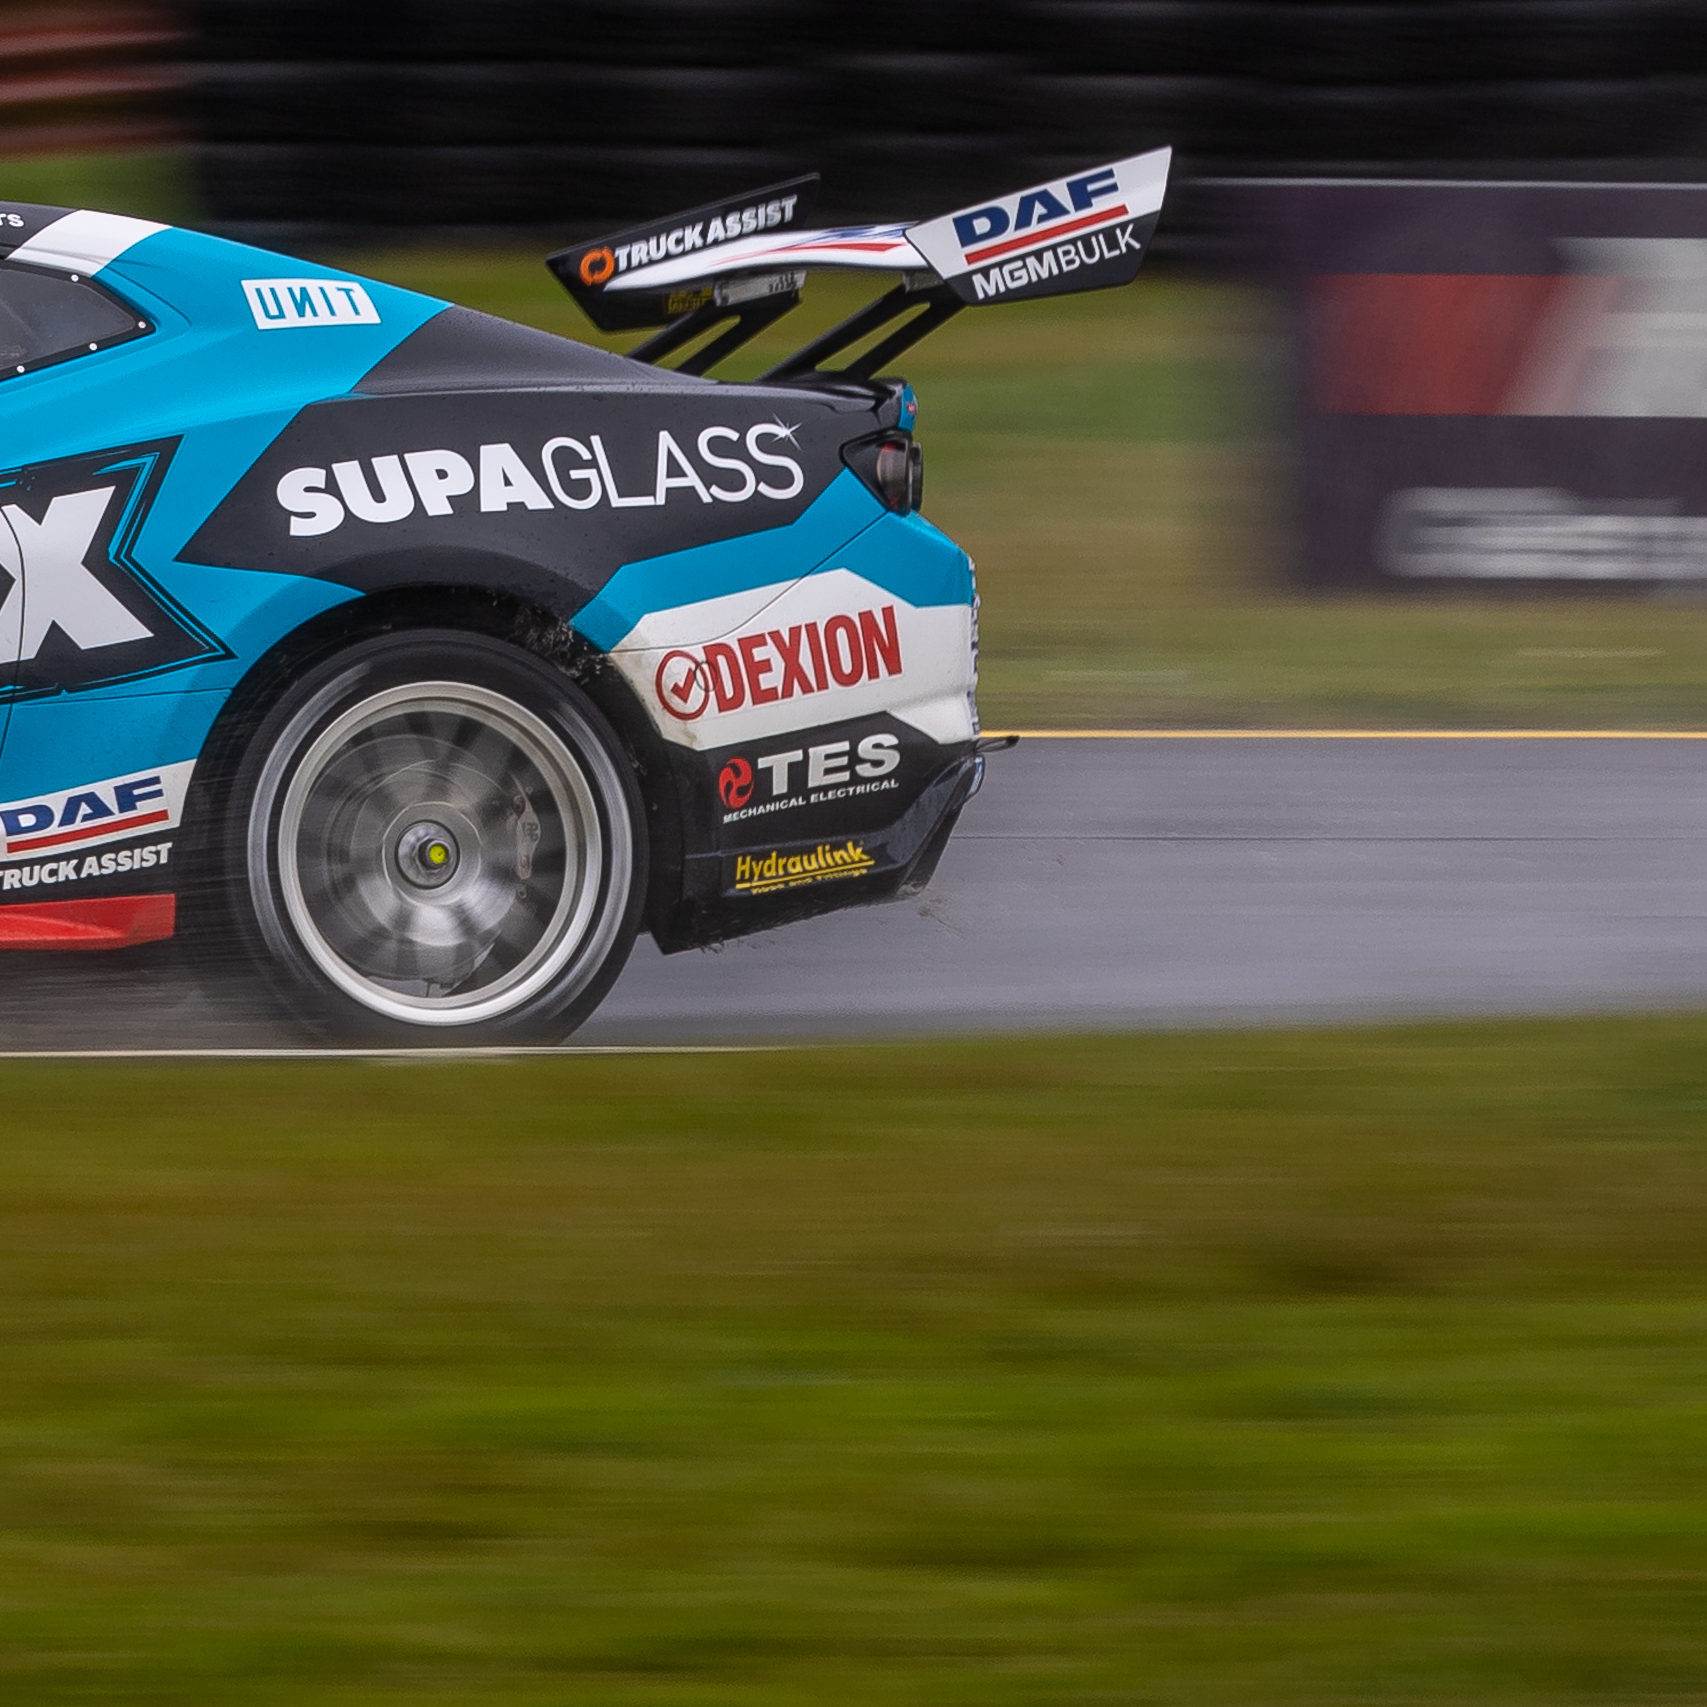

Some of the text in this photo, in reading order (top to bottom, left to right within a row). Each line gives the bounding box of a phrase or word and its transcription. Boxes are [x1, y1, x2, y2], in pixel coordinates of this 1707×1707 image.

[615, 195, 797, 272] TRUCK ASSIST
[953, 168, 1119, 248] DAF
[972, 224, 1141, 300] MGMBULK
[258, 284, 365, 325] UNIT
[276, 422, 804, 537] SUPAGLASS
[702, 606, 902, 714] DEXION
[758, 733, 900, 796] TES
[723, 779, 899, 824] MECHANICAL ELECTRICAL
[80, 843, 173, 878] ASSIST
[736, 841, 870, 881] Hydraulink
